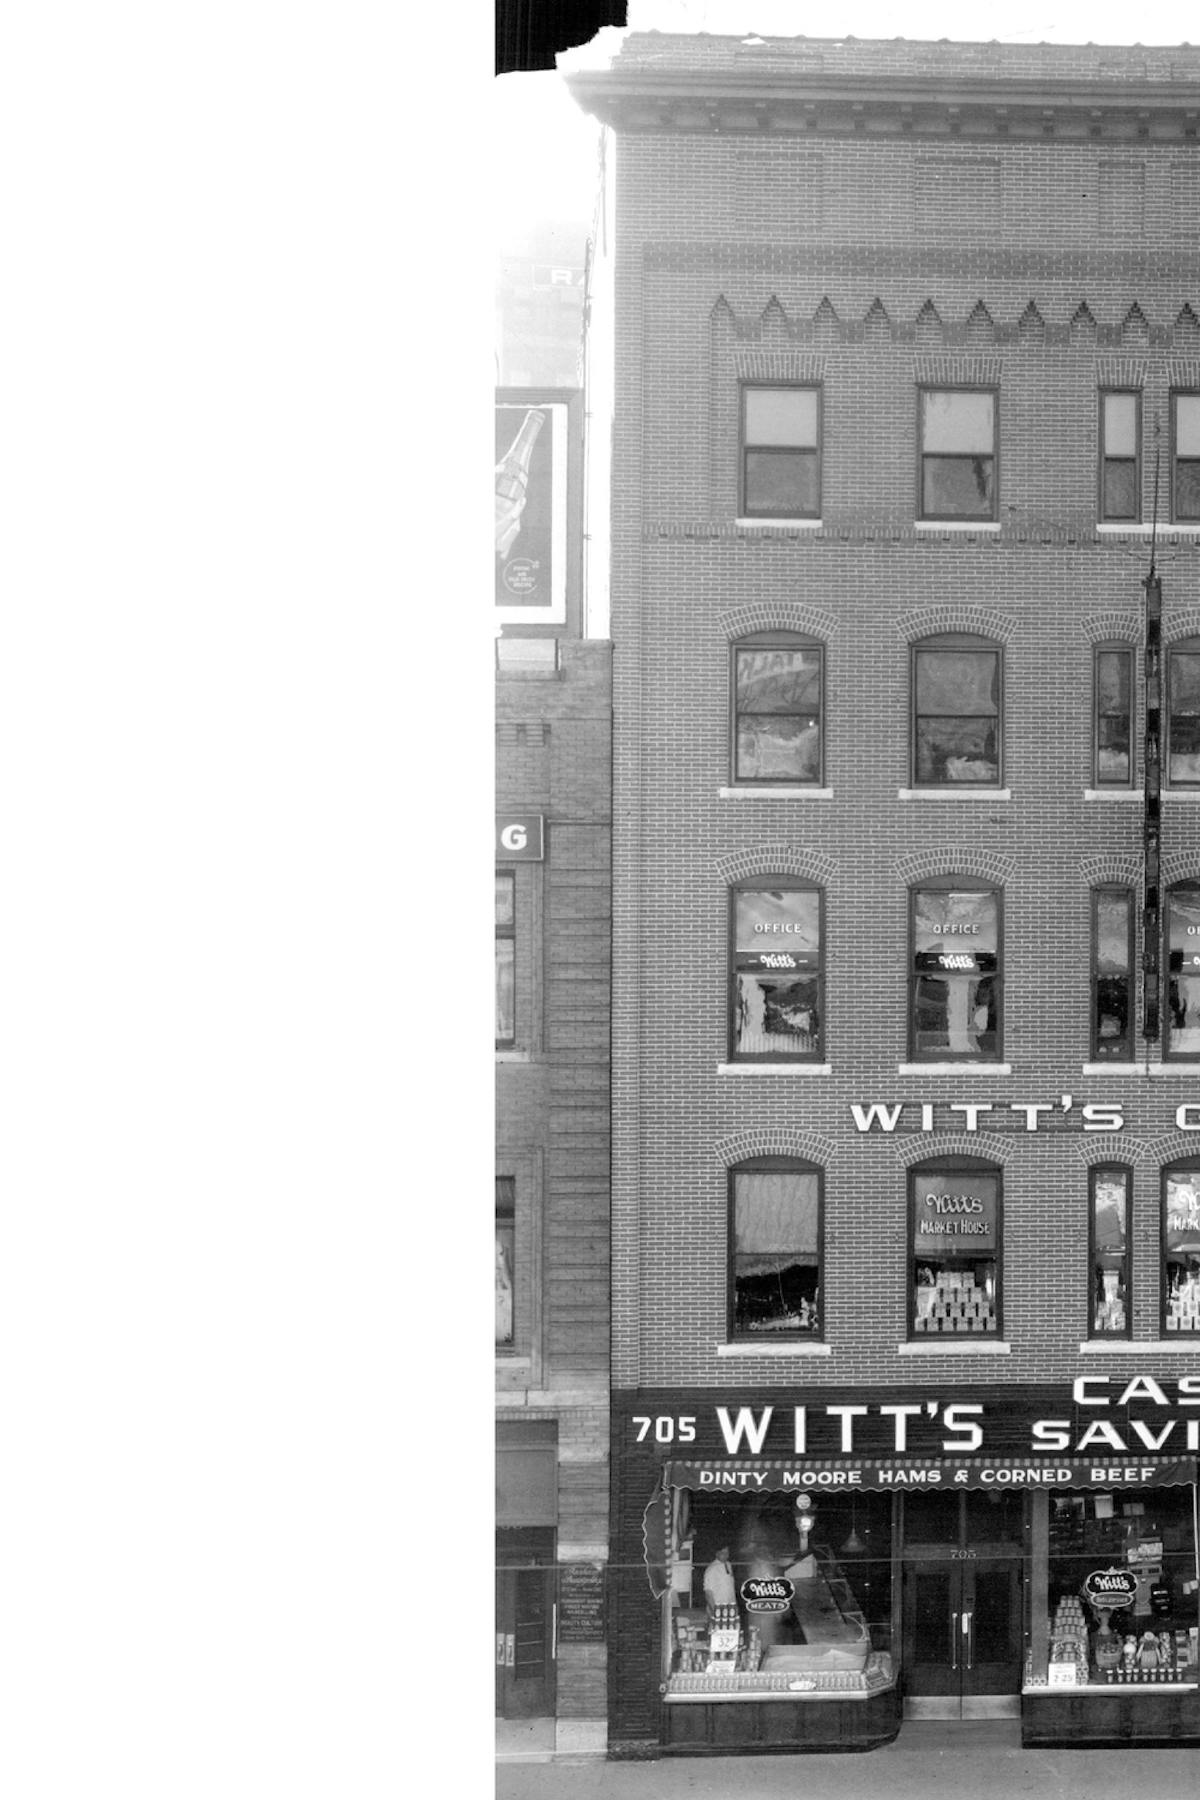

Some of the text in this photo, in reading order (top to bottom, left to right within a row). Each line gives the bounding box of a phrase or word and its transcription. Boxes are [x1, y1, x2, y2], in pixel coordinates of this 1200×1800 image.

[499, 823, 528, 851] G
[754, 923, 801, 934] OFFICE
[933, 924, 980, 935] OFFICE
[850, 1094, 1124, 1131] WITT'S
[632, 1416, 697, 1443] 705
[716, 1401, 983, 1455] WITT'S
[700, 1467, 1156, 1486] DINTY MOORE HAMS & CORNED BEEF
[950, 1549, 977, 1560] 705
[750, 1600, 785, 1609] MEATS
